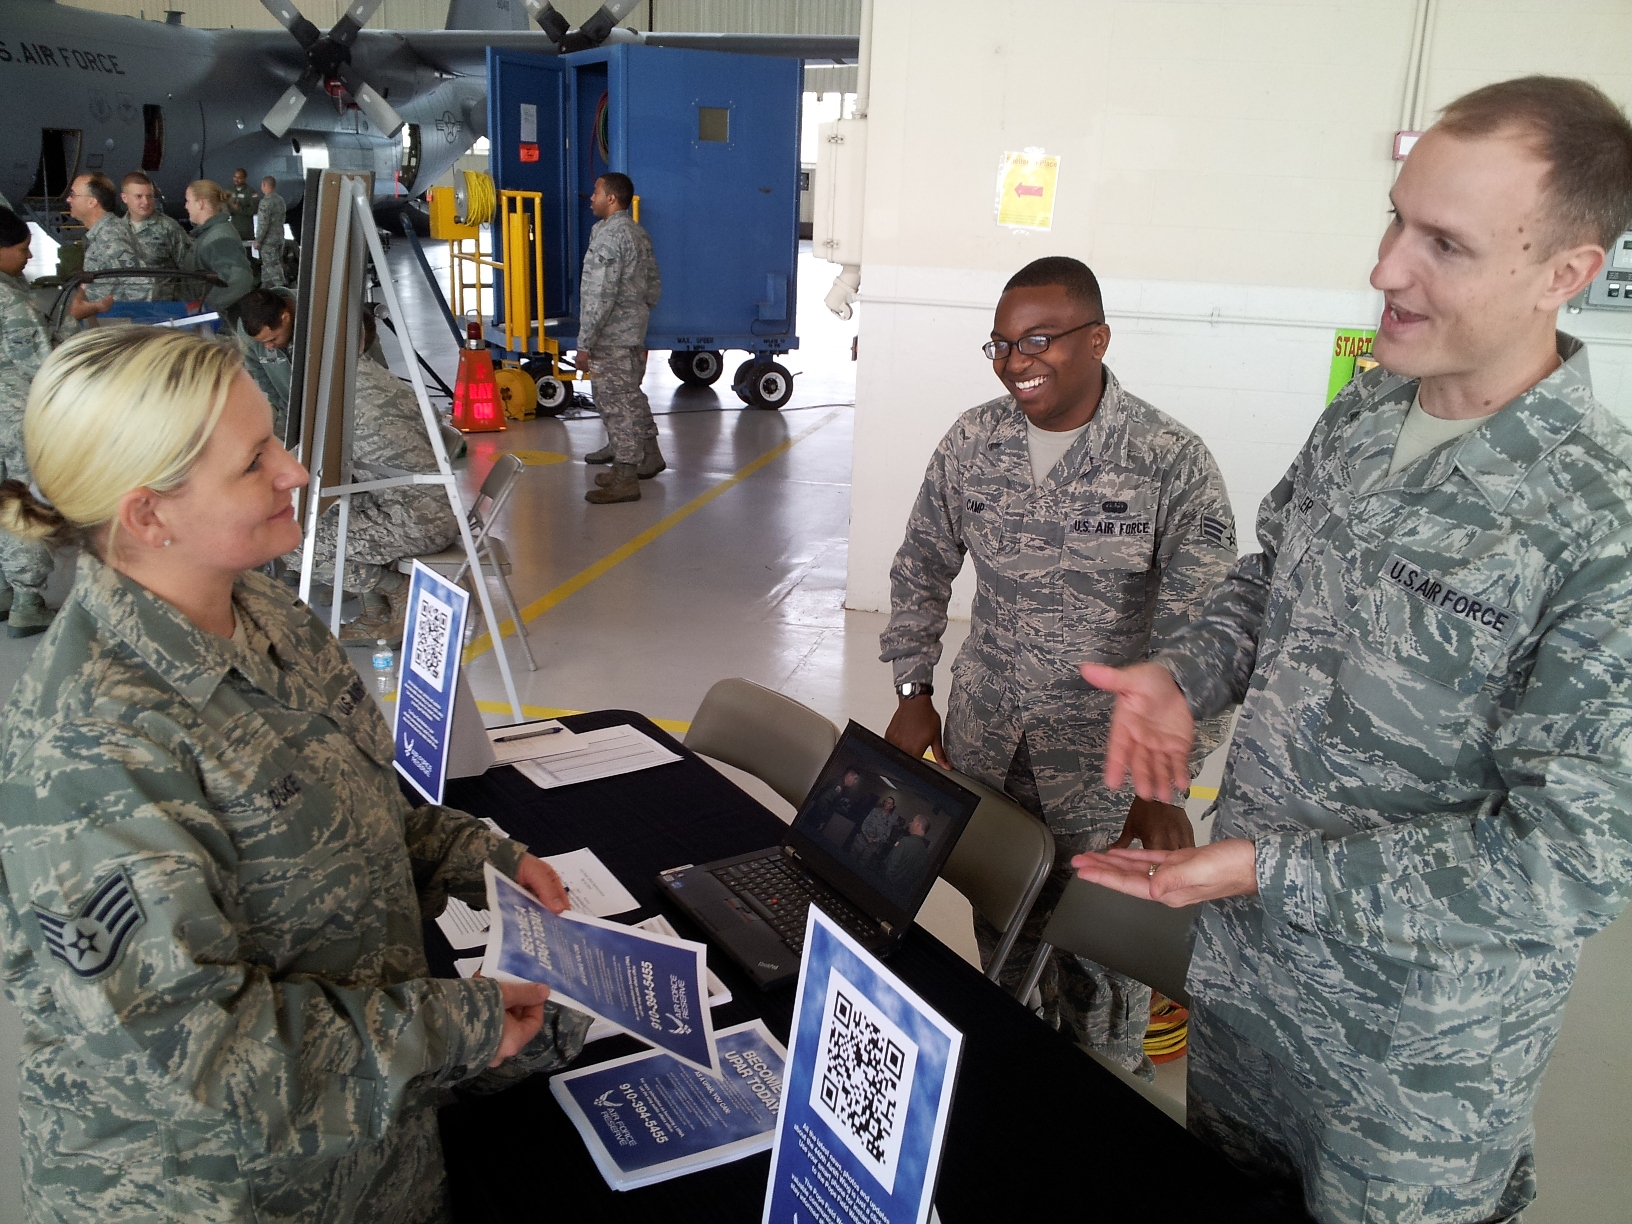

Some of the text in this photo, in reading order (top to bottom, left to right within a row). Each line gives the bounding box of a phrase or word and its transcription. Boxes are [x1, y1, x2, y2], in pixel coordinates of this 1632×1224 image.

[20, 42, 59, 67] AIR
[57, 46, 126, 75] FORCE
[1335, 335, 1372, 357] START
[473, 402, 494, 419] ON
[966, 499, 985, 512] CAMP
[1074, 519, 1150, 535] U.S. AIR FORCE
[1420, 577, 1443, 602] AIR
[1439, 590, 1509, 633] FORCE
[641, 961, 662, 1030] 910-394-5455
[670, 974, 679, 1003] FORCE
[678, 980, 689, 1019] RESERVE
[724, 1050, 754, 1078] UPAR
[742, 1050, 783, 1093] BECOME
[601, 1111, 628, 1146] RESERVE
[607, 1108, 637, 1146] AIR FORCE
[619, 1083, 669, 1143] 910-394-5455
[816, 1138, 830, 1157] latest
[843, 1170, 860, 1192] photos
[860, 1189, 870, 1203] and
[870, 1200, 890, 1224] updates
[818, 1163, 831, 1181] smart
[831, 1178, 845, 1197] phone
[825, 1180, 837, 1198] Pope
[837, 1195, 849, 1212] Field
[813, 1188, 825, 1205] Pope
[825, 1202, 836, 1219] Field
